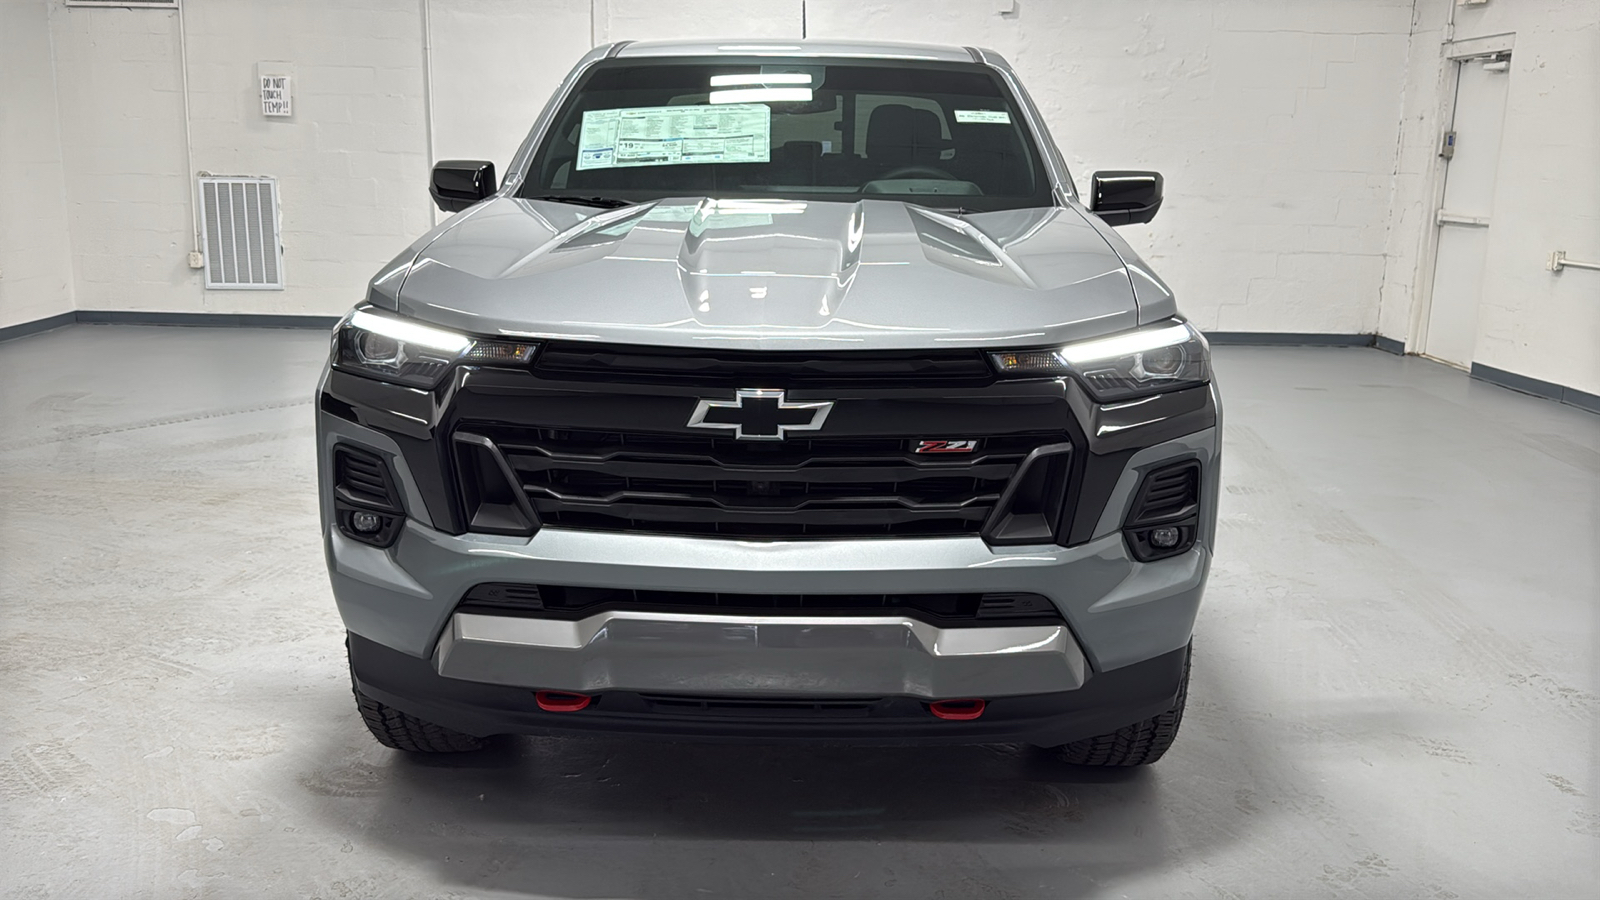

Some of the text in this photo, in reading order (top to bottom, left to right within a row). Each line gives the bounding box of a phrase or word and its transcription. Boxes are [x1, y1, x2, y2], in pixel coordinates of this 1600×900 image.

[263, 78, 286, 89] DO NOT
[263, 90, 282, 100] TOUCH
[915, 440, 977, 453] Z71
